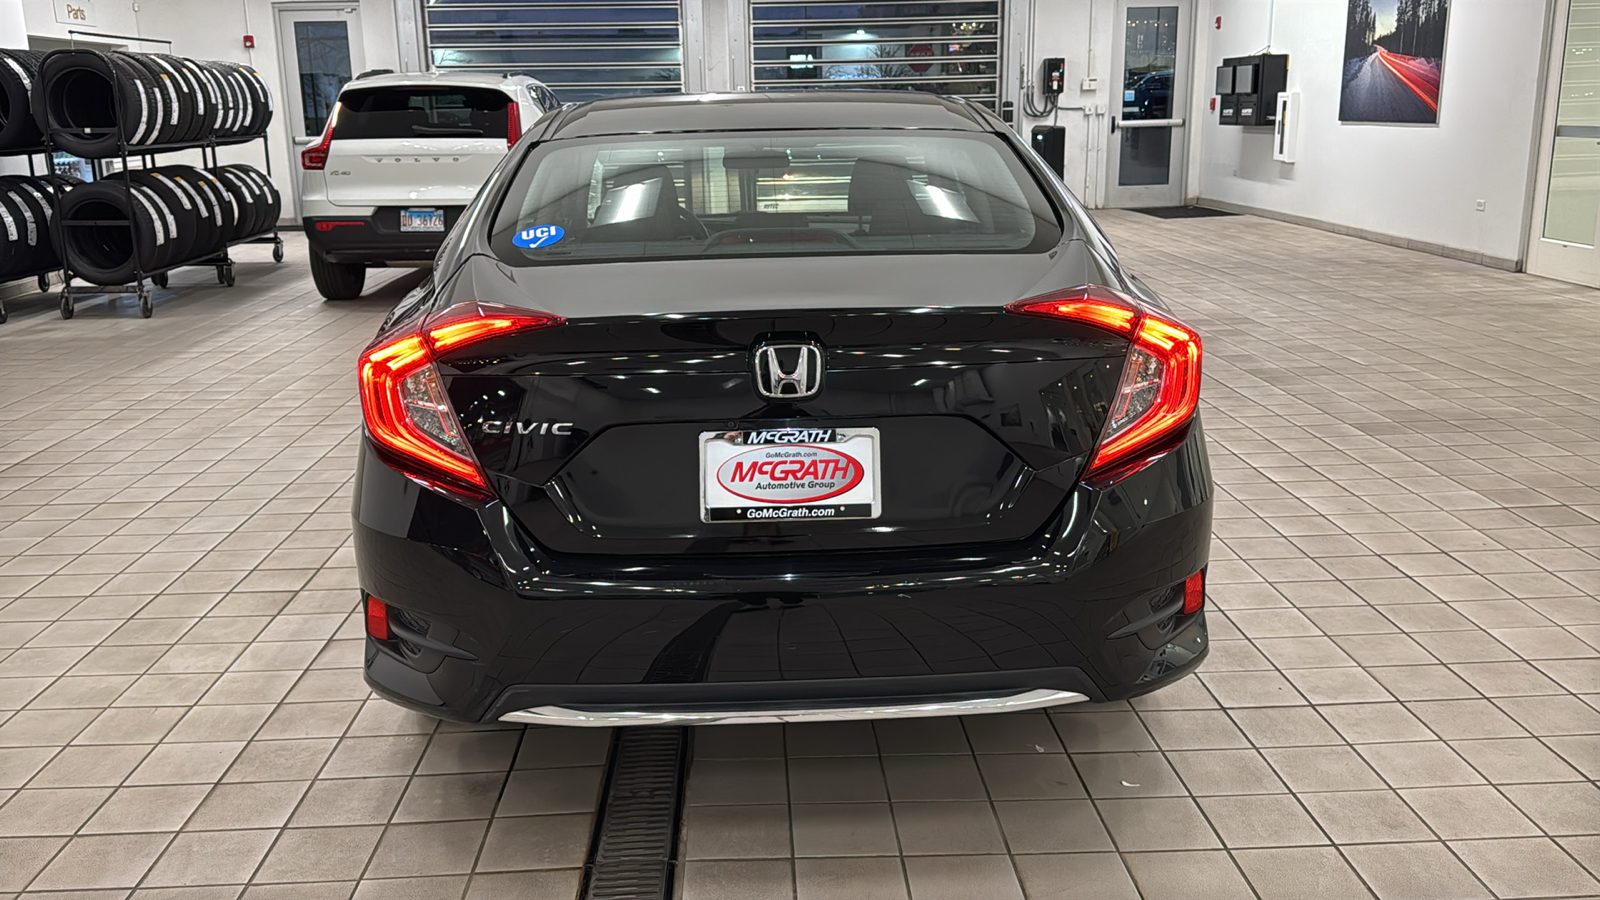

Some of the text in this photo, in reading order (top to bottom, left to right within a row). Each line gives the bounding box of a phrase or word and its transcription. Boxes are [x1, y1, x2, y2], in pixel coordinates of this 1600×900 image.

[66, 4, 86, 20] Parts
[521, 226, 556, 240] UCI
[482, 421, 574, 435] CIVIC
[765, 451, 818, 459] GoMcGrath.com
[755, 481, 836, 490] Automotive Group
[746, 507, 835, 519] GoMcGrath.com
